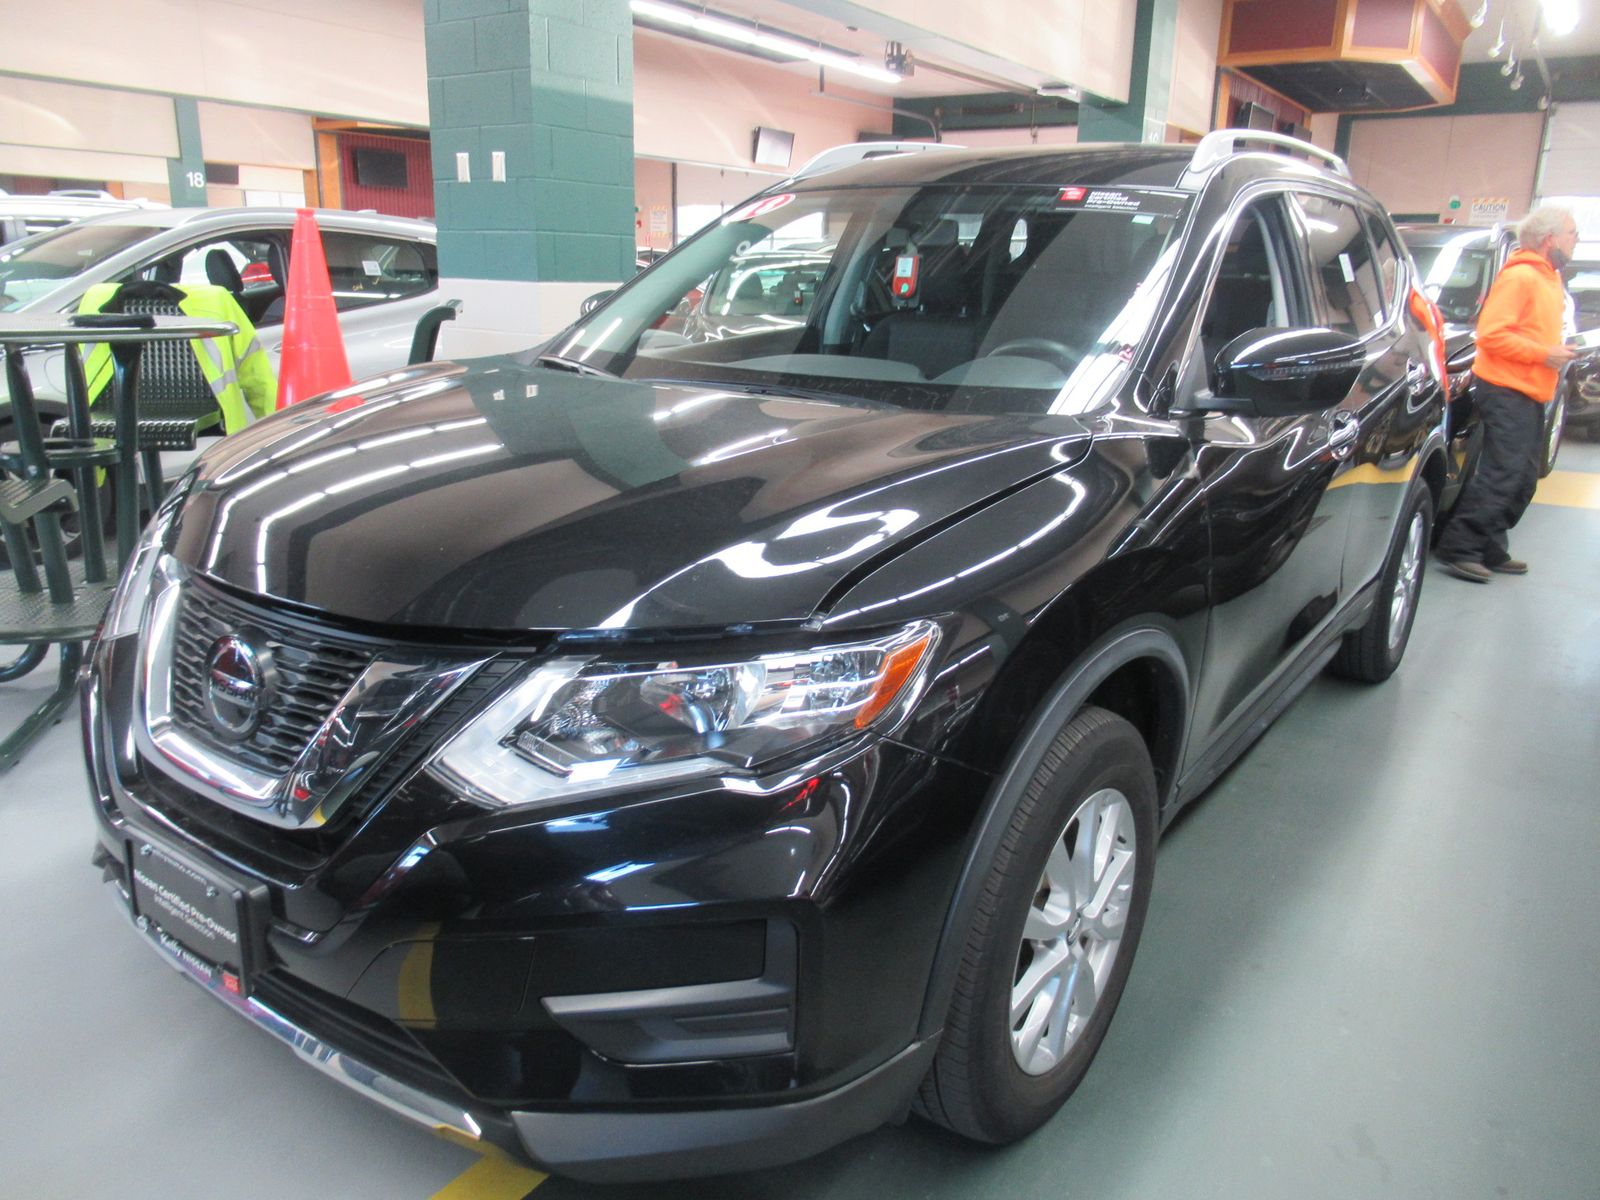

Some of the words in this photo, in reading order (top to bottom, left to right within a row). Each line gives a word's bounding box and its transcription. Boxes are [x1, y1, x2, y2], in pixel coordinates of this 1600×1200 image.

[186, 171, 205, 188] 18
[1473, 203, 1506, 211] CAUTION
[133, 868, 159, 894] Nissan
[159, 885, 190, 913] Certified
[190, 905, 237, 944] Pre-Owned
[159, 932, 182, 958] Kelly
